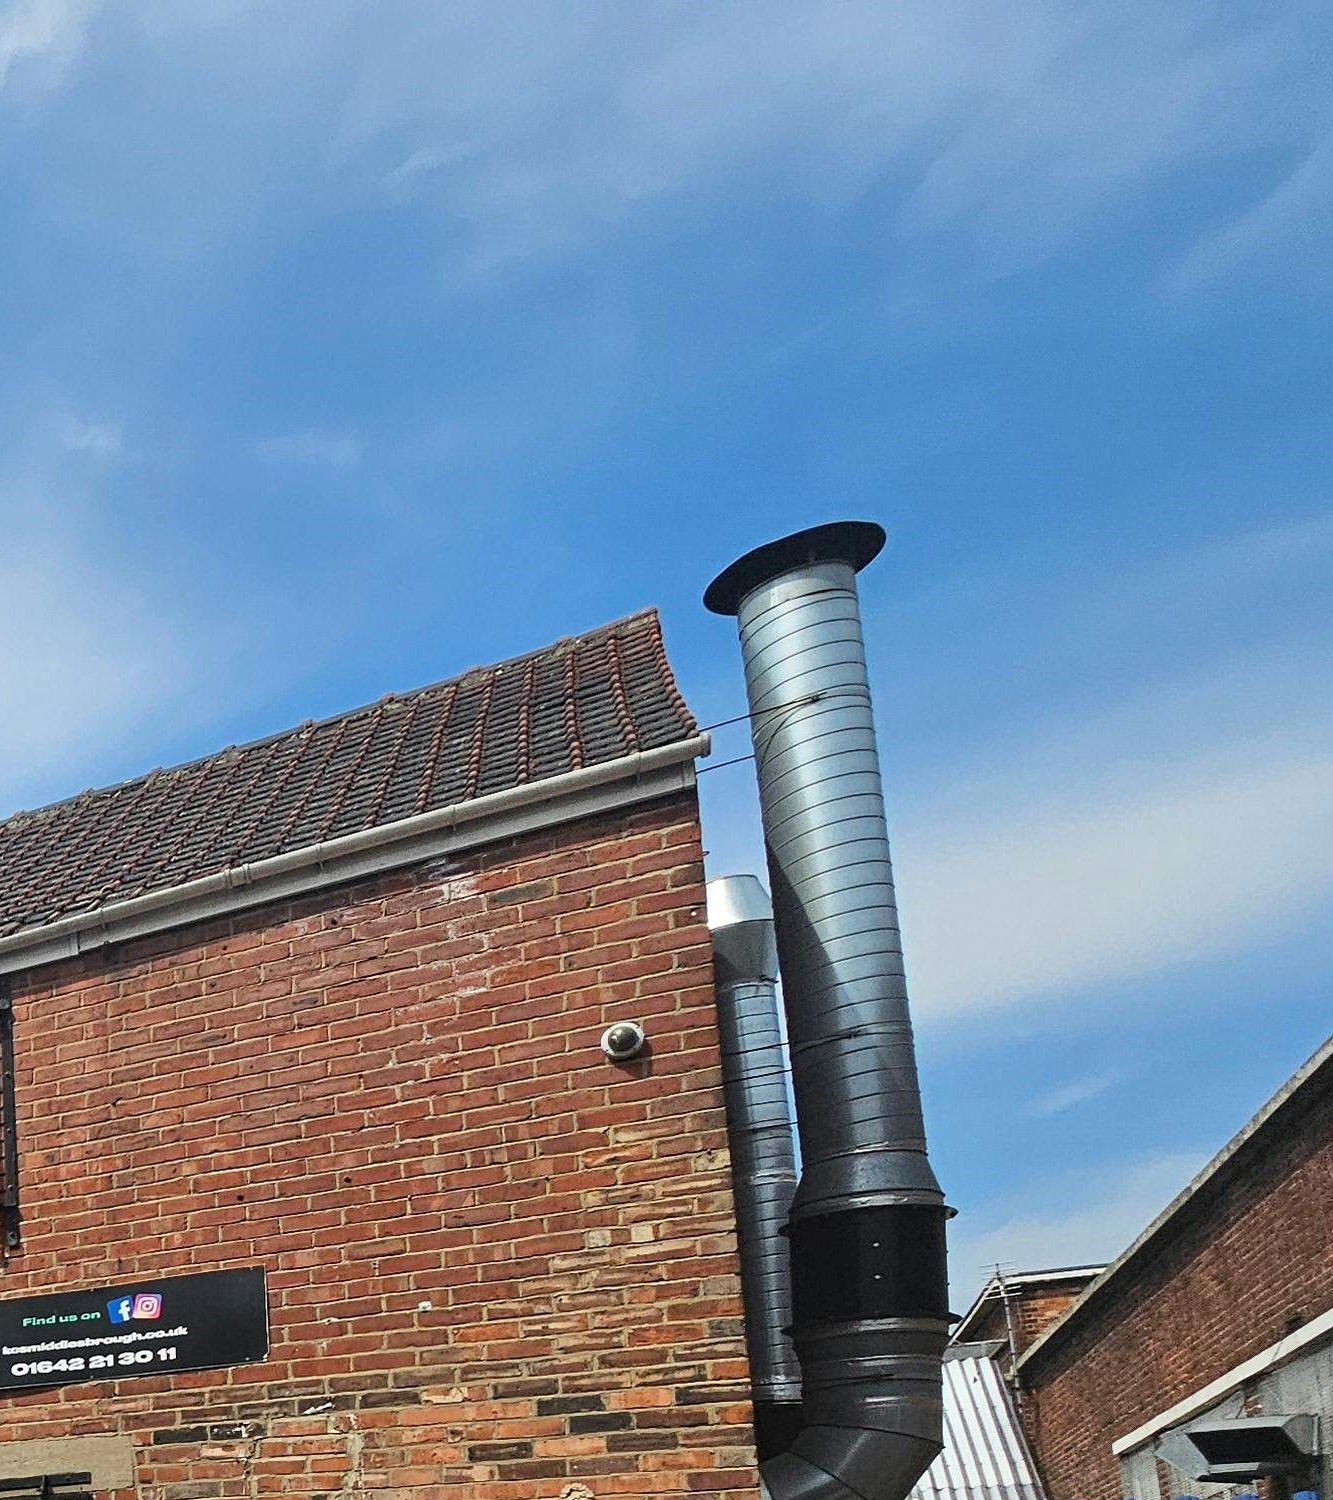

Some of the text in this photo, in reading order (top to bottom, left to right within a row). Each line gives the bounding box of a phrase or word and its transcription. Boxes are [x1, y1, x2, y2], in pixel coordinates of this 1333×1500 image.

[22, 1315, 56, 1327] Find
[59, 1314, 78, 1323] us
[80, 1311, 101, 1321] on
[11, 1347, 177, 1376] 01642 21 30 11
